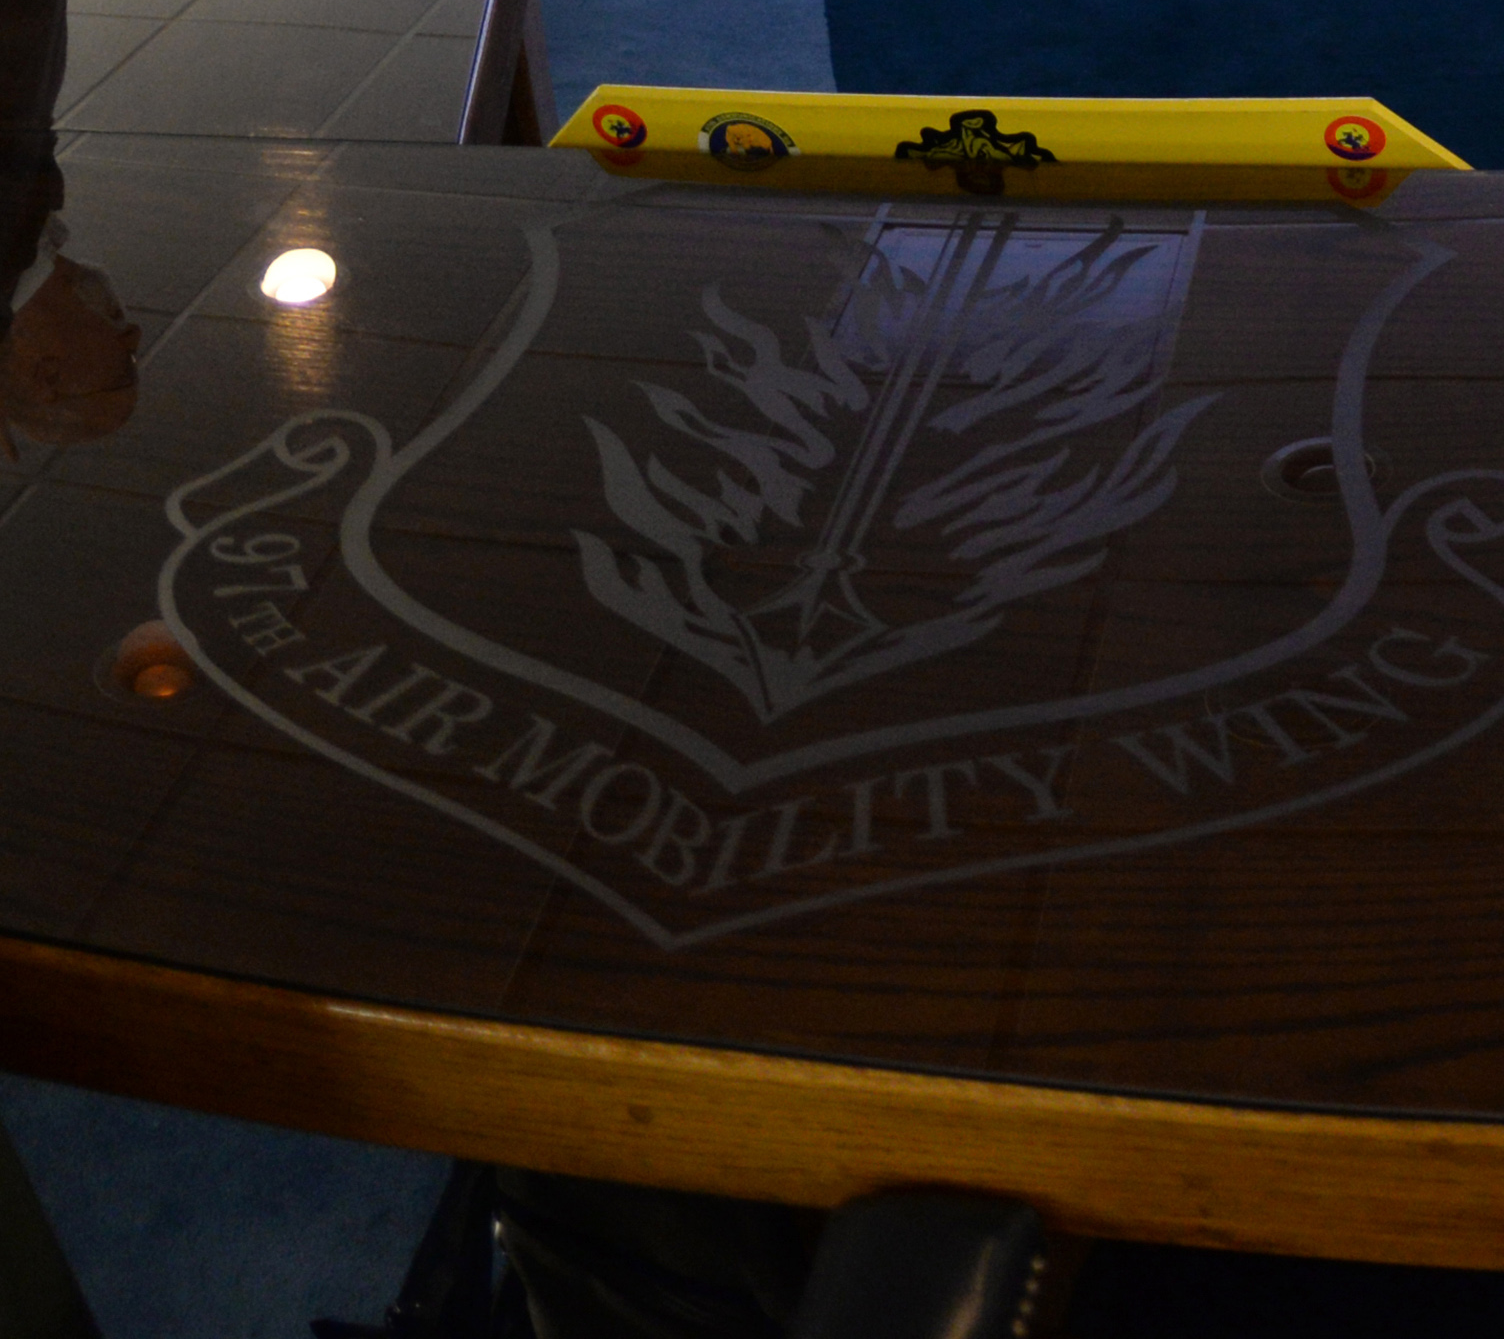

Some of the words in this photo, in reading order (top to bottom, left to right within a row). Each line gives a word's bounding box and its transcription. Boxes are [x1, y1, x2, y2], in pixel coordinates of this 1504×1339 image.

[210, 530, 306, 654] 97TH
[294, 637, 496, 749] AIR
[476, 711, 1078, 900] MOBILITY
[1112, 626, 1490, 798] WING
